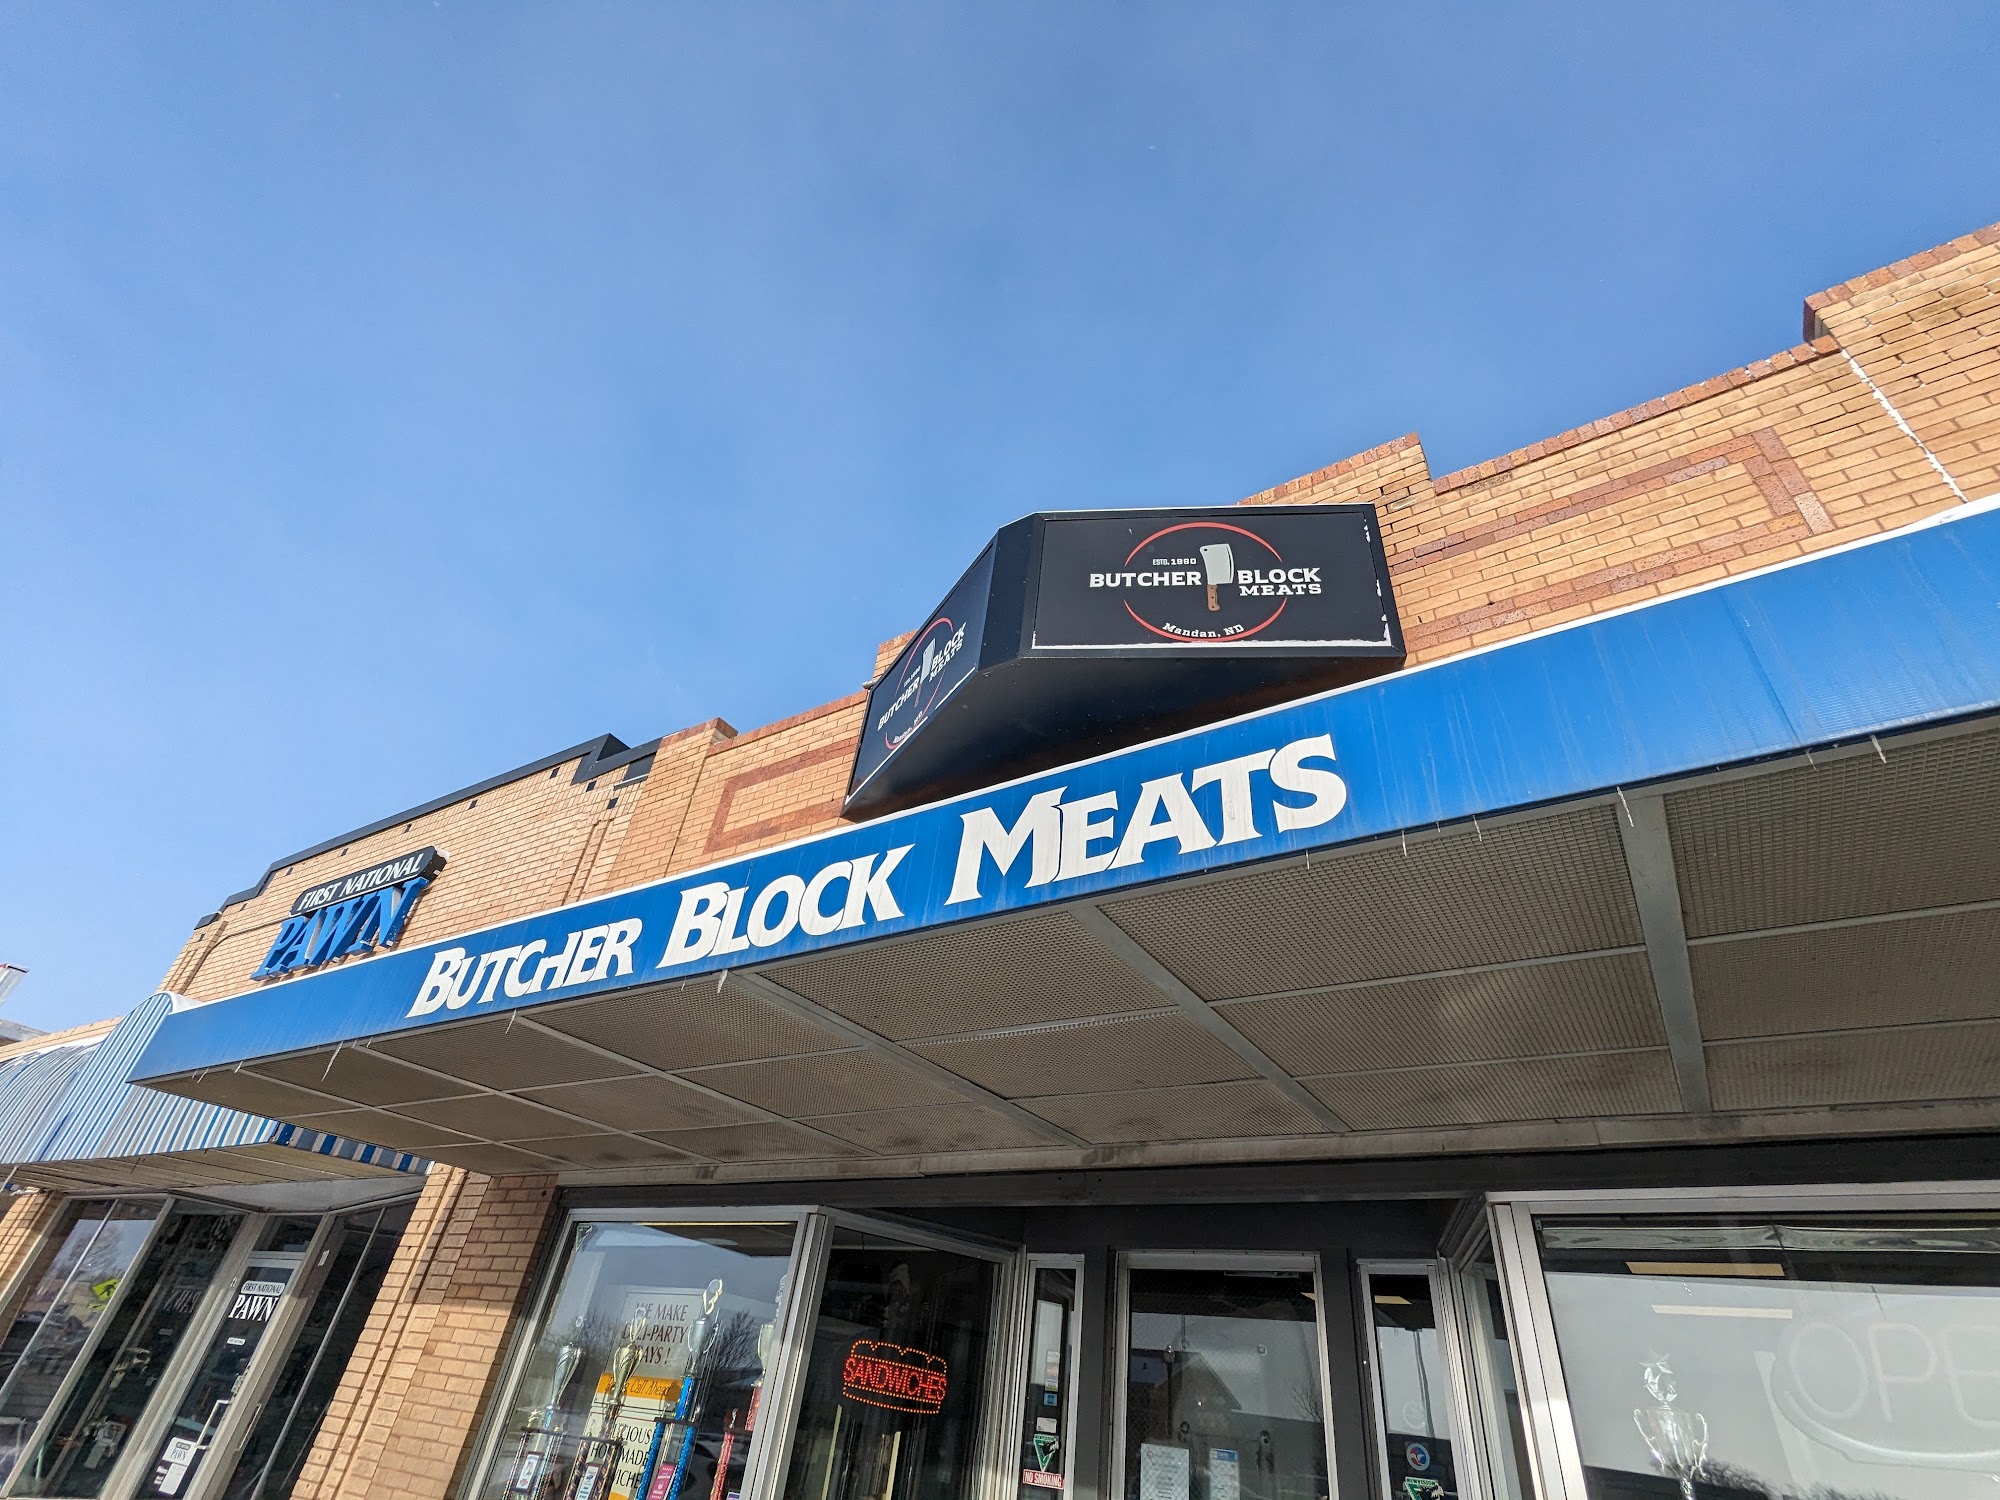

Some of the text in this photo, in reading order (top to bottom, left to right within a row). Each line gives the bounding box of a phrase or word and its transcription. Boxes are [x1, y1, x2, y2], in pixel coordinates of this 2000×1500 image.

[1089, 567, 1322, 588] BUTCHER BLOCK
[1239, 583, 1322, 597] MEATS
[1162, 622, 1245, 639] Mandan, ND
[929, 638, 963, 683] MEATS
[877, 676, 920, 731] BUTCHER
[931, 621, 967, 670] BLOCK
[296, 853, 425, 912] FIRST NATIONAL
[404, 733, 1348, 1019] BUTCHER BLOCK MEATS
[250, 876, 430, 982] PAWN
[228, 1294, 279, 1322] PAWN
[654, 1303, 688, 1322] MAKE
[843, 1356, 947, 1401] SANDWICHES
[590, 1441, 649, 1467] HOMADE
[1025, 1470, 1062, 1488] NO SMOKING
